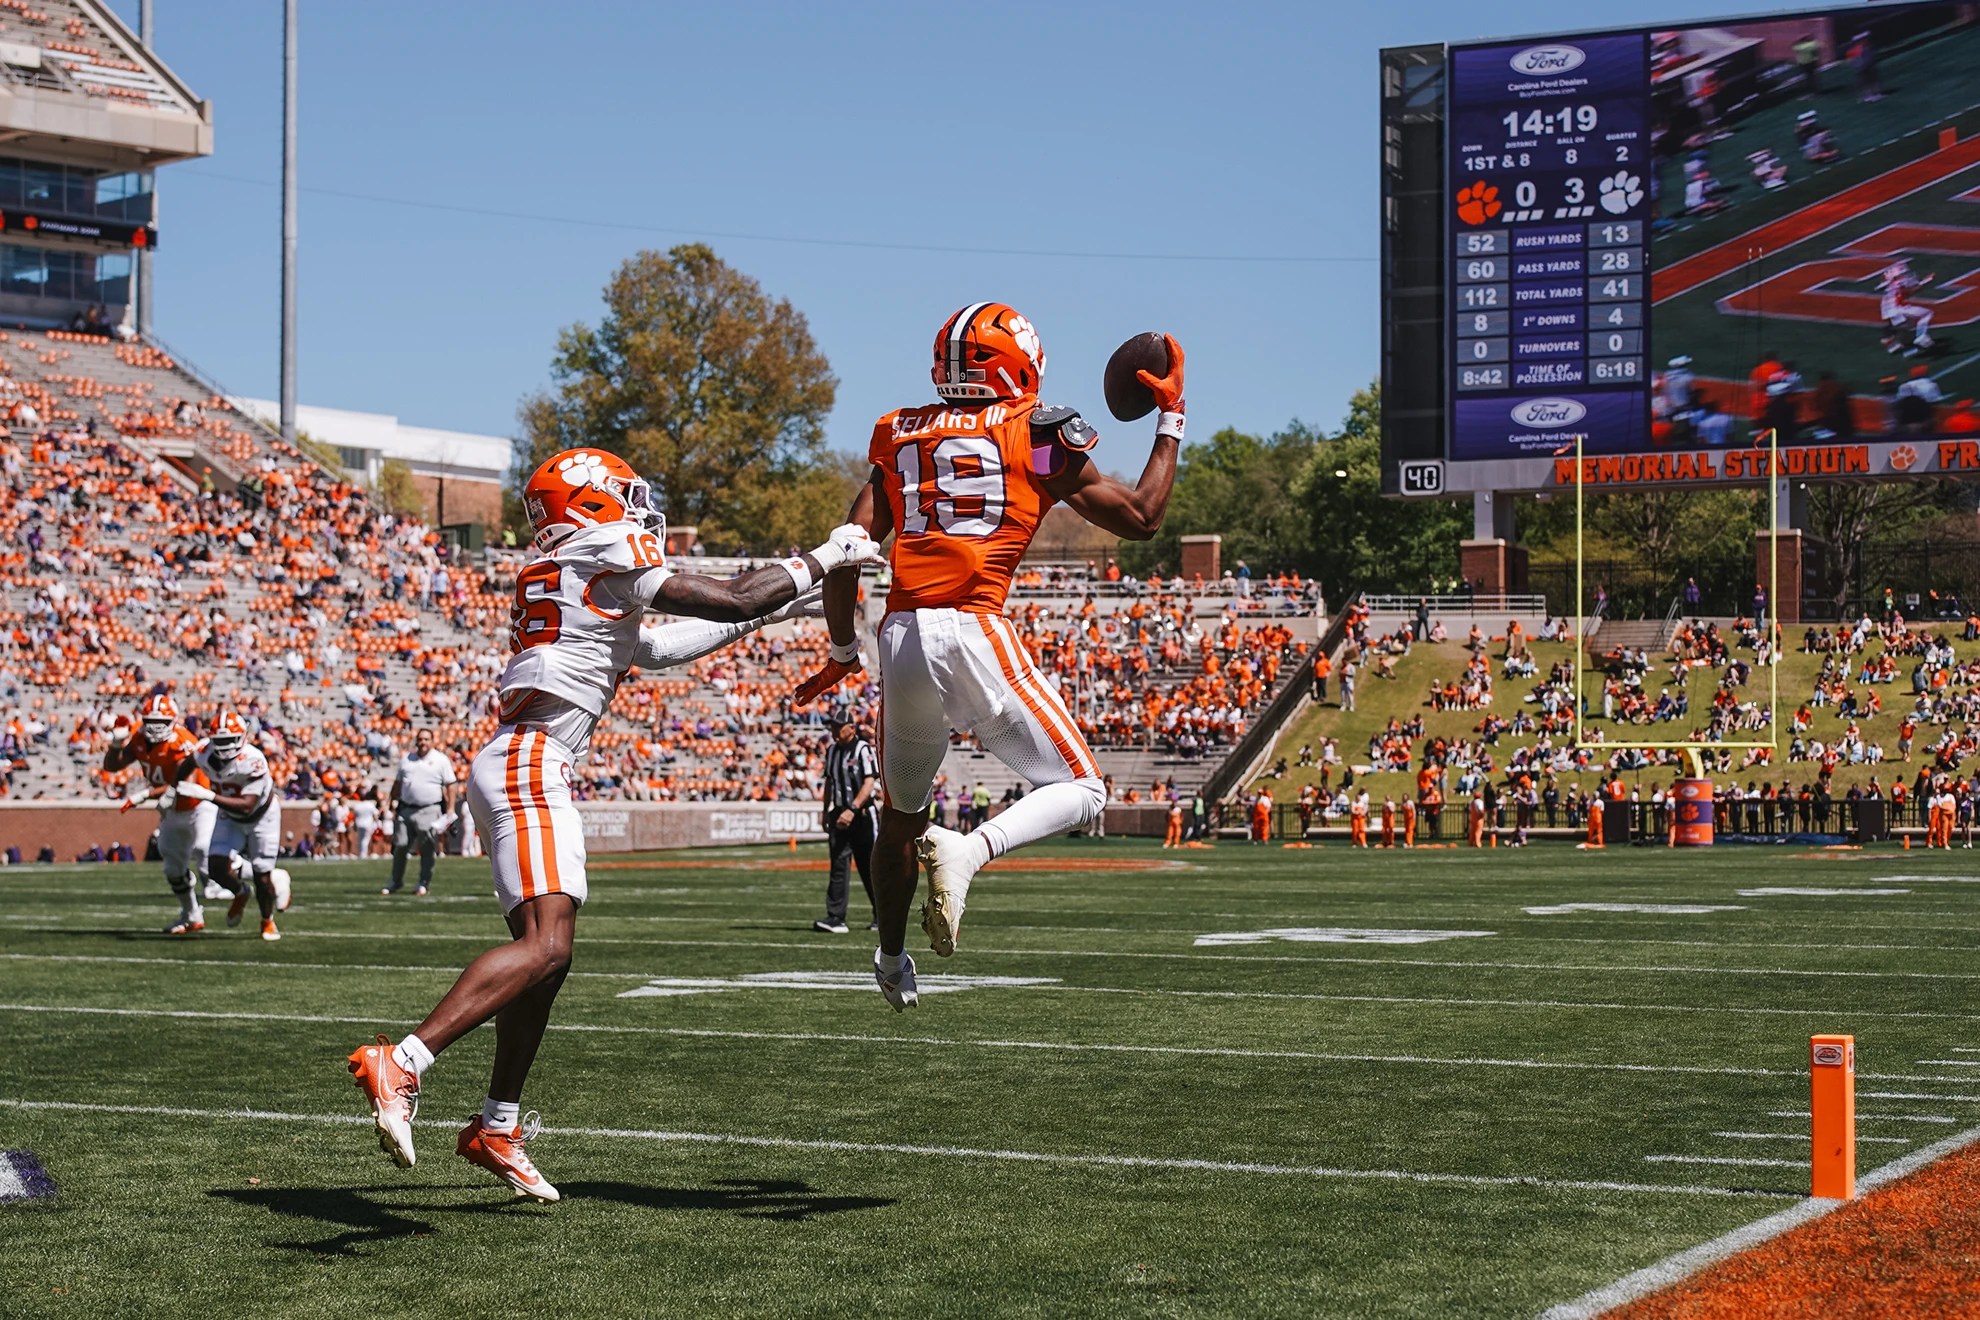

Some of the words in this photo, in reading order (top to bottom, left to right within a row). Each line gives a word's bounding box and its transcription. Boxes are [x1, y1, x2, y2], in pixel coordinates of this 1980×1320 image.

[1525, 50, 1570, 69] Ford
[1507, 81, 1540, 91] Carolina
[1541, 79, 1558, 89] Ford
[1559, 78, 1588, 87] Dealers
[1503, 105, 1597, 137] 14:19
[1505, 140, 1537, 149] DISTANCE
[1556, 136, 1574, 145] BALL
[1574, 135, 1585, 144] ON
[1605, 132, 1637, 141] QUARTER
[1462, 144, 1483, 153] DOWN
[1565, 148, 1578, 164] 8
[1616, 146, 1629, 162] 2
[1464, 155, 1497, 171] 1ST
[1502, 154, 1515, 168] &
[1519, 152, 1531, 167] 8
[1515, 180, 1537, 207] 0
[1564, 177, 1585, 204] 3
[1516, 236, 1545, 247] RUSH
[1548, 233, 1582, 245] YARDS
[1602, 225, 1629, 243] 13
[1467, 234, 1495, 252] 52
[1467, 260, 1495, 279] 60
[1517, 262, 1544, 274] PASS
[1547, 260, 1581, 272] YARDS
[1602, 252, 1630, 270] 28
[1516, 289, 1546, 301] TOTAL
[1549, 287, 1583, 299] YARDS
[1602, 278, 1629, 297] 41
[1465, 288, 1497, 306] 112
[1474, 314, 1488, 332] 8
[1537, 314, 1576, 326] DOWNS
[1608, 308, 1623, 325] 4
[1474, 341, 1488, 359] 0
[1518, 340, 1581, 354] TURNOVERS
[1608, 334, 1623, 351] 0
[1463, 370, 1502, 386] 8:42
[1516, 371, 1582, 384] POSSESSION
[1528, 365, 1555, 376] TIME
[1556, 364, 1571, 374] OF
[1596, 361, 1636, 378] 6:18
[1526, 404, 1570, 422] Ford
[891, 407, 978, 441] SELLARS
[985, 405, 1007, 428] III
[1508, 434, 1540, 443] Carolina
[1541, 432, 1559, 441] Ford
[1559, 431, 1589, 441] Dealrs
[1938, 441, 1980, 469] FR
[1554, 452, 1717, 485] MEMORIAL
[1725, 446, 1870, 478] STADIUM
[1408, 466, 1437, 489] 40
[895, 435, 1007, 538] 19
[627, 533, 664, 567] 16
[581, 811, 631, 824] OMINION
